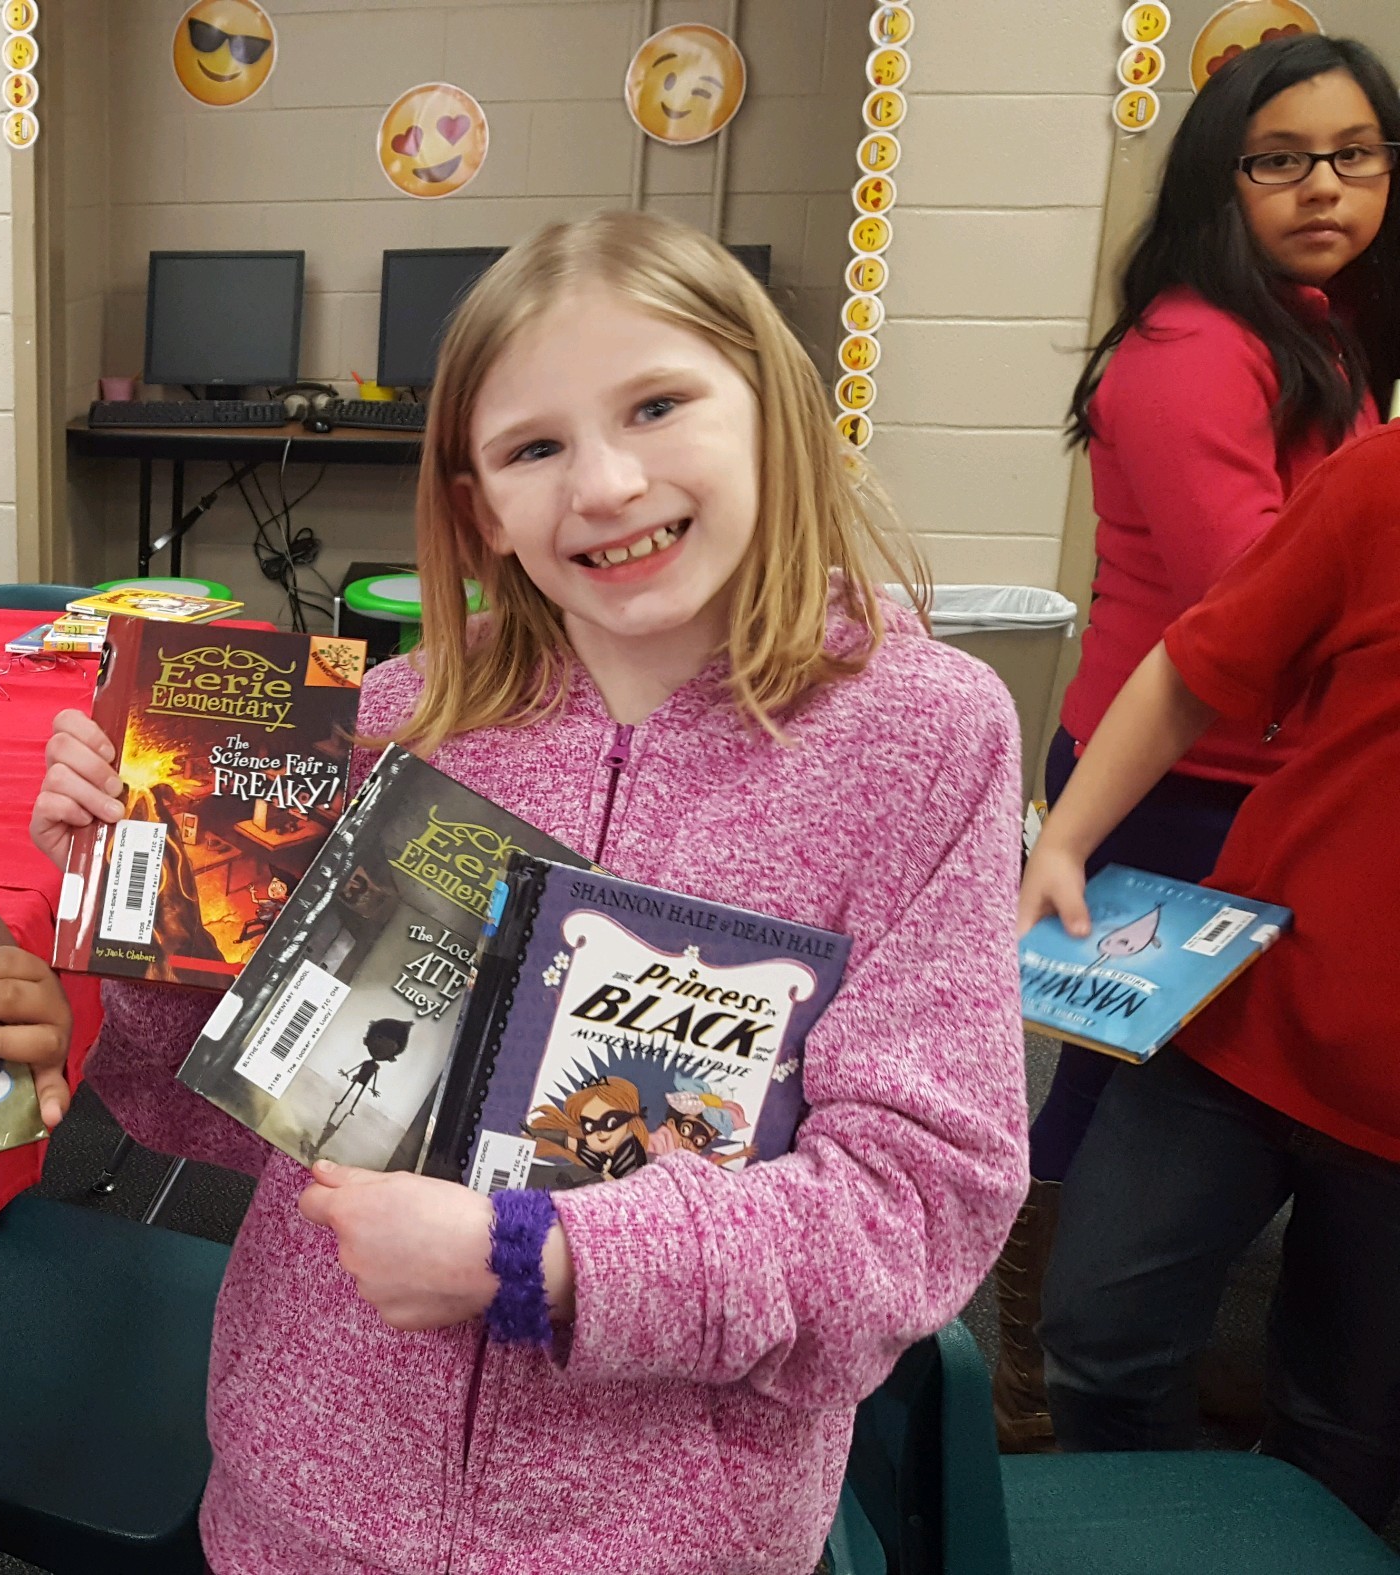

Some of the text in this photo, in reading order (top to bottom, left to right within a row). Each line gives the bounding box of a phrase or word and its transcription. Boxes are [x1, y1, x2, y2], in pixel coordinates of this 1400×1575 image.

[154, 661, 292, 698] Eerie
[150, 685, 292, 732] Elementary
[208, 746, 339, 776] Science Fair is
[226, 734, 250, 750] The
[210, 766, 340, 815] FREAKY!
[114, 850, 123, 885] ELEMENTARY
[409, 924, 434, 942] The
[570, 881, 666, 918] SHANNON
[667, 905, 717, 932] HALE
[731, 919, 785, 947] DEAN
[786, 934, 836, 960] HALE
[95, 947, 104, 957] by
[320, 984, 339, 1010] FIC CHA
[393, 972, 451, 1019] Lucy!
[405, 952, 469, 1000] ATE
[633, 962, 771, 1013] Princess
[241, 968, 309, 1068] BLYTHE-BOWER ELEMENTARY SCHOOL
[286, 1007, 334, 1074] The locker ate Lucy!
[568, 983, 775, 1058] BLACK
